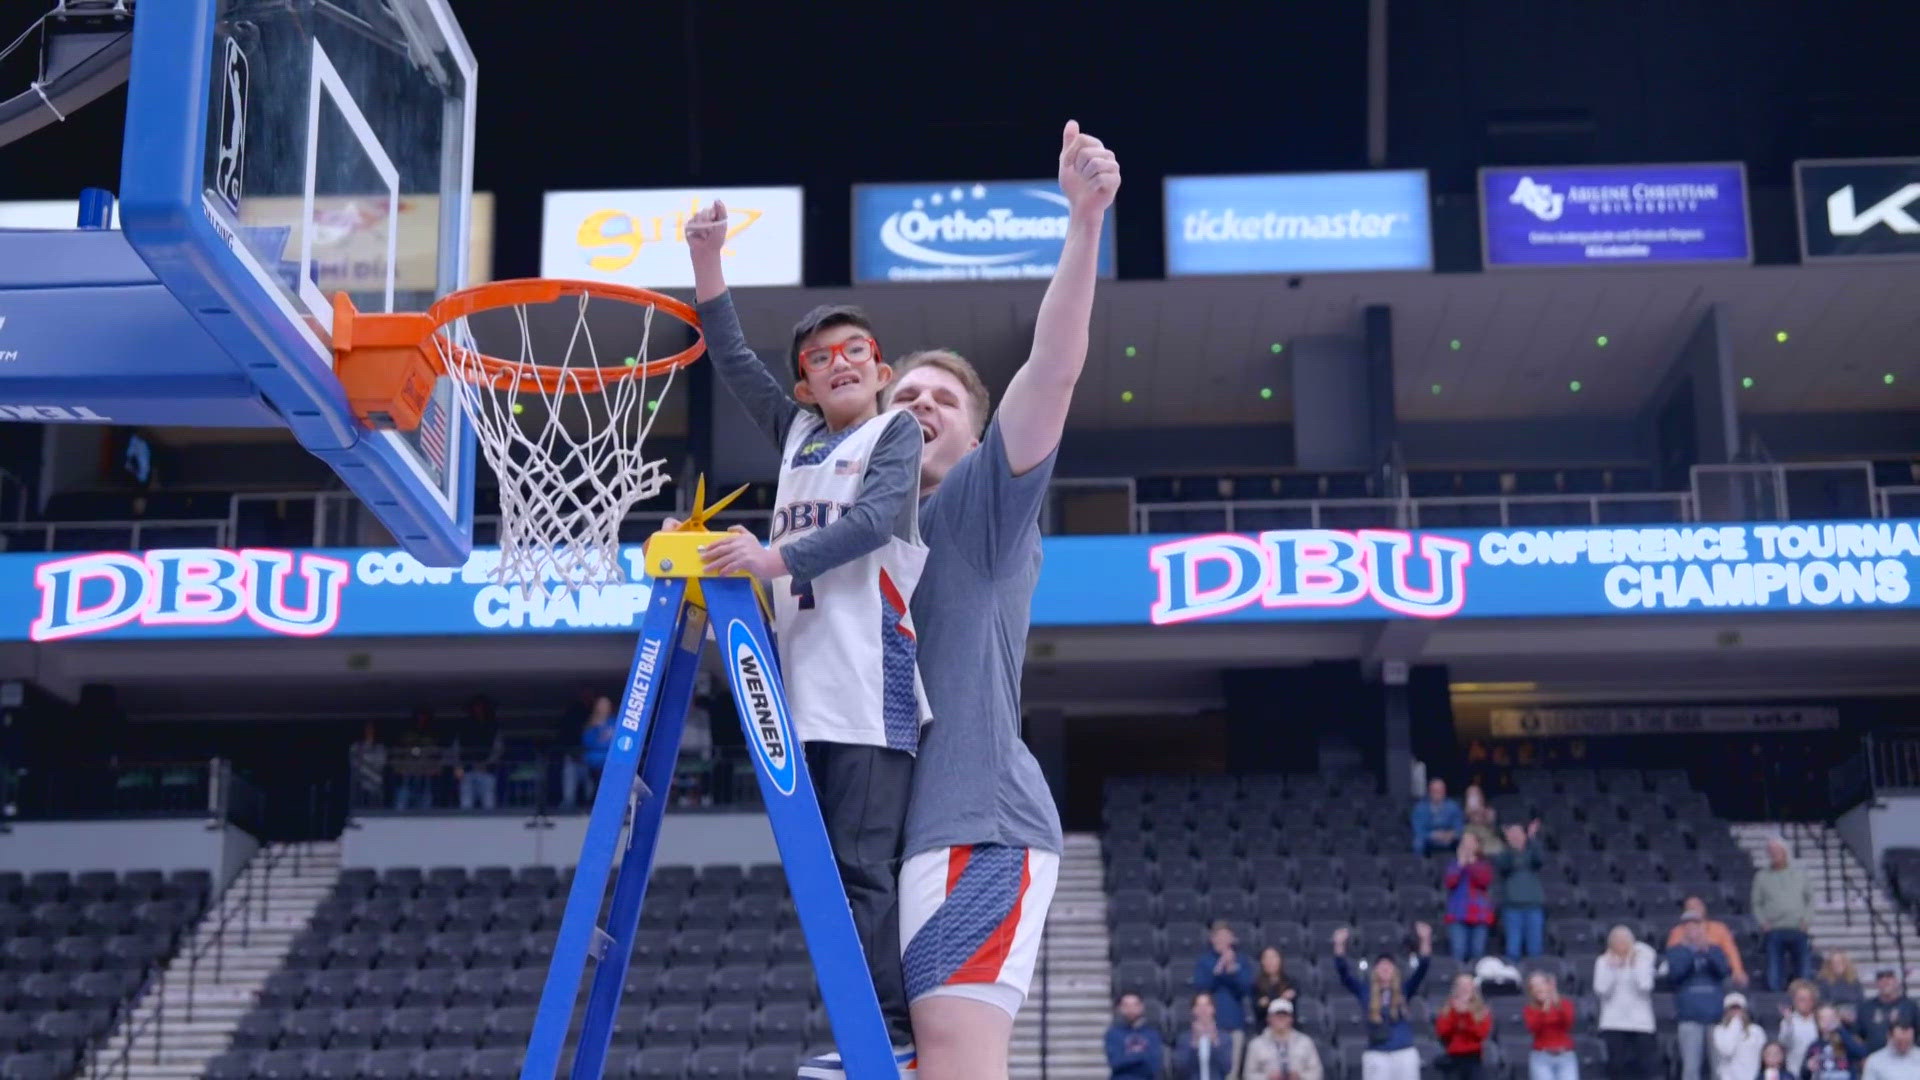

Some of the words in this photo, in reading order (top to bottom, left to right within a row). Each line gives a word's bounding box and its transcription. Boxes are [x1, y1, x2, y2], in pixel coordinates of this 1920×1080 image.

[1183, 207, 1396, 242] ticketmaster
[1151, 529, 1471, 625] DBU
[1479, 526, 1749, 566] CONFERENCE
[1754, 522, 1920, 560] TOURNA
[30, 549, 349, 641] DBU
[474, 584, 652, 628] CHAMP
[1604, 559, 1911, 609] CHAMPIONS
[622, 638, 662, 732] BASKETBALL
[740, 655, 784, 760] WERNER
